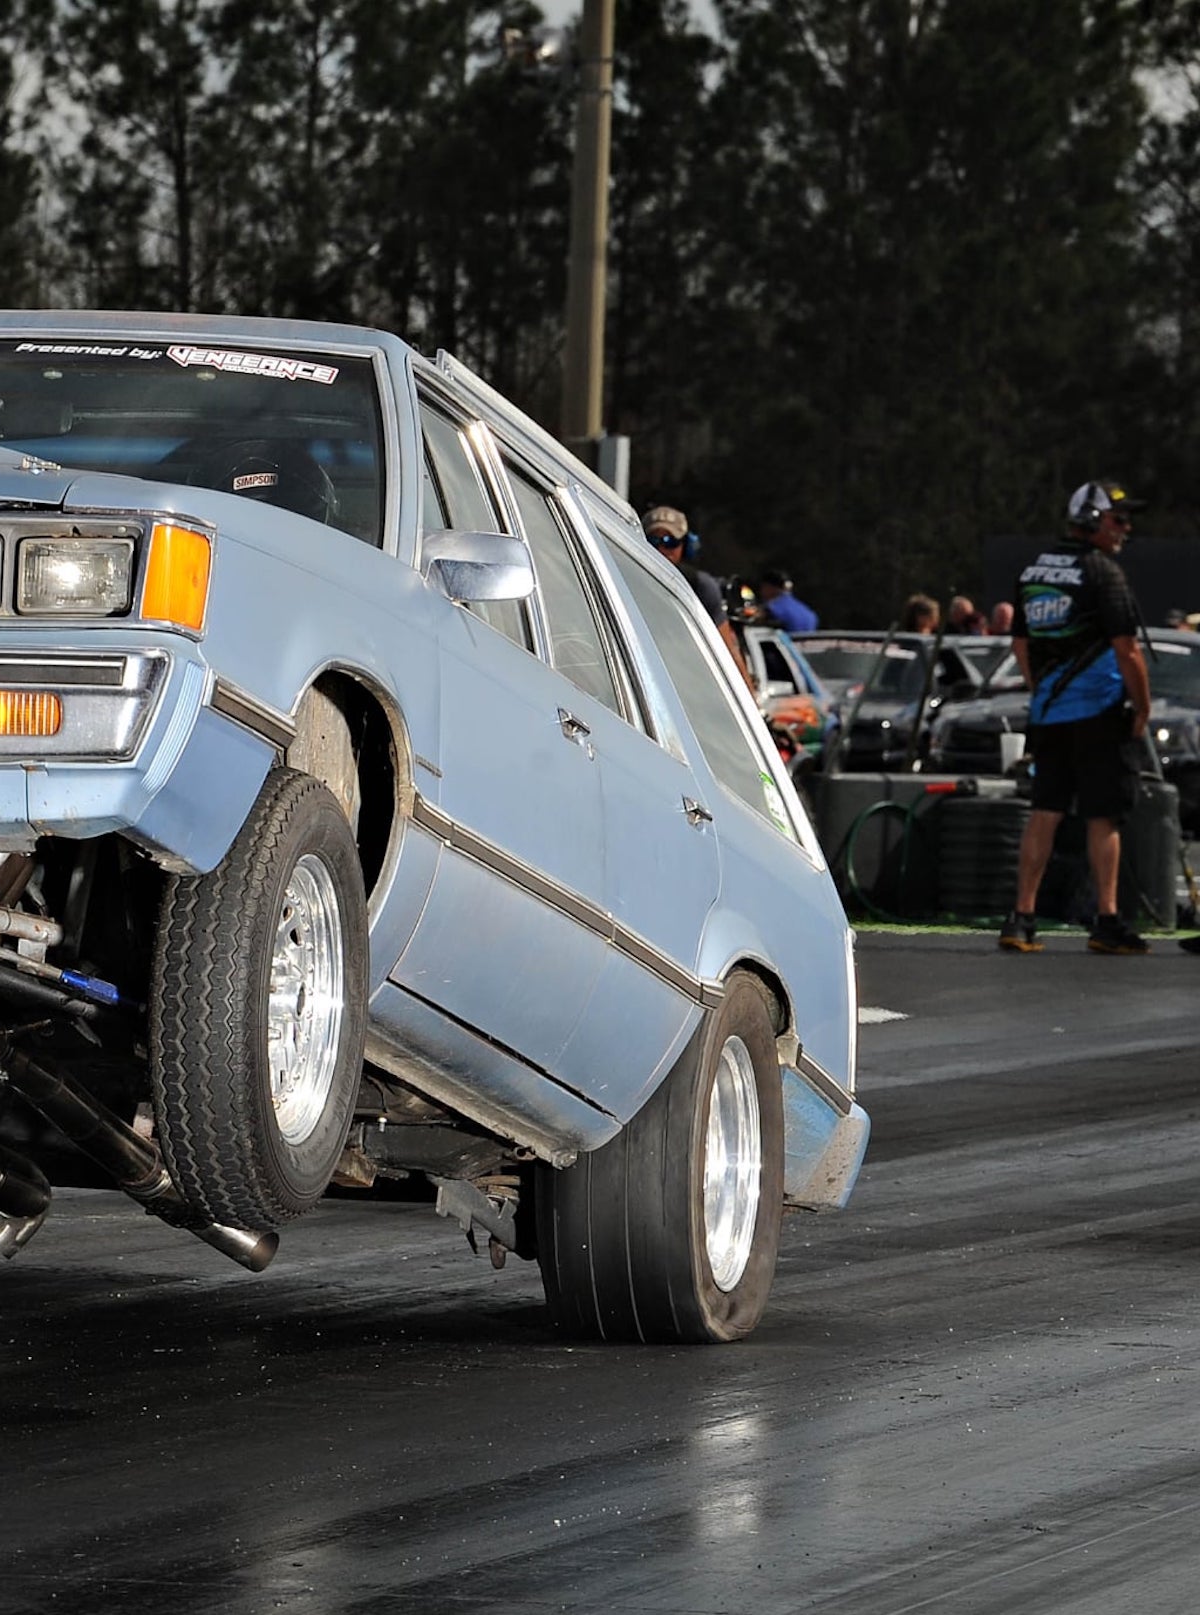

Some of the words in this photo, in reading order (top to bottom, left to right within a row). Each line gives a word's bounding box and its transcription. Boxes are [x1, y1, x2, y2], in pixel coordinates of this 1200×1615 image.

[16, 343, 128, 356] Presented
[129, 347, 163, 360] by:
[168, 346, 337, 383] VENGEANCE
[235, 474, 278, 489] SIMPSON
